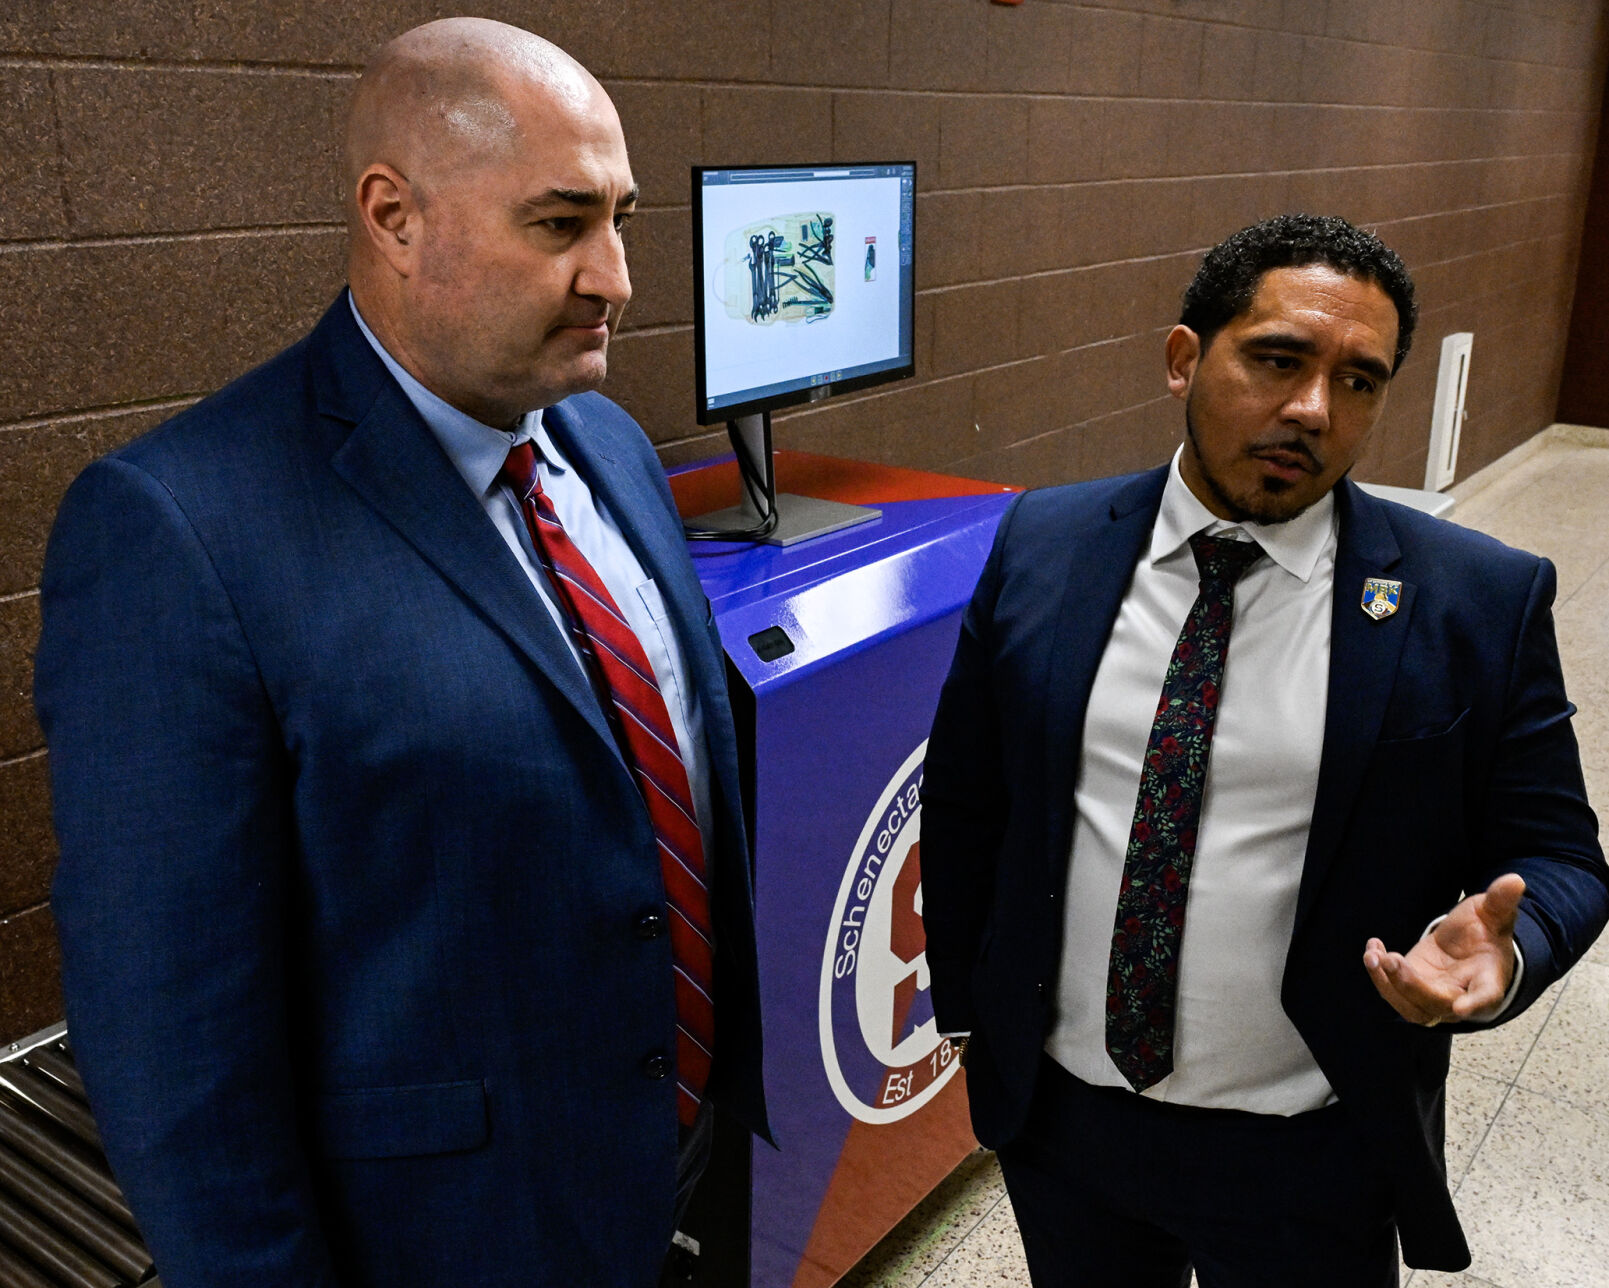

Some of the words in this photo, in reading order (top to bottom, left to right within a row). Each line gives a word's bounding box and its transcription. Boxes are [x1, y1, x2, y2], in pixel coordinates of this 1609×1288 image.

[1374, 603, 1383, 612] S
[835, 774, 923, 979] Schenecta
[882, 1069, 914, 1105] Est
[930, 1038, 960, 1077] 18
